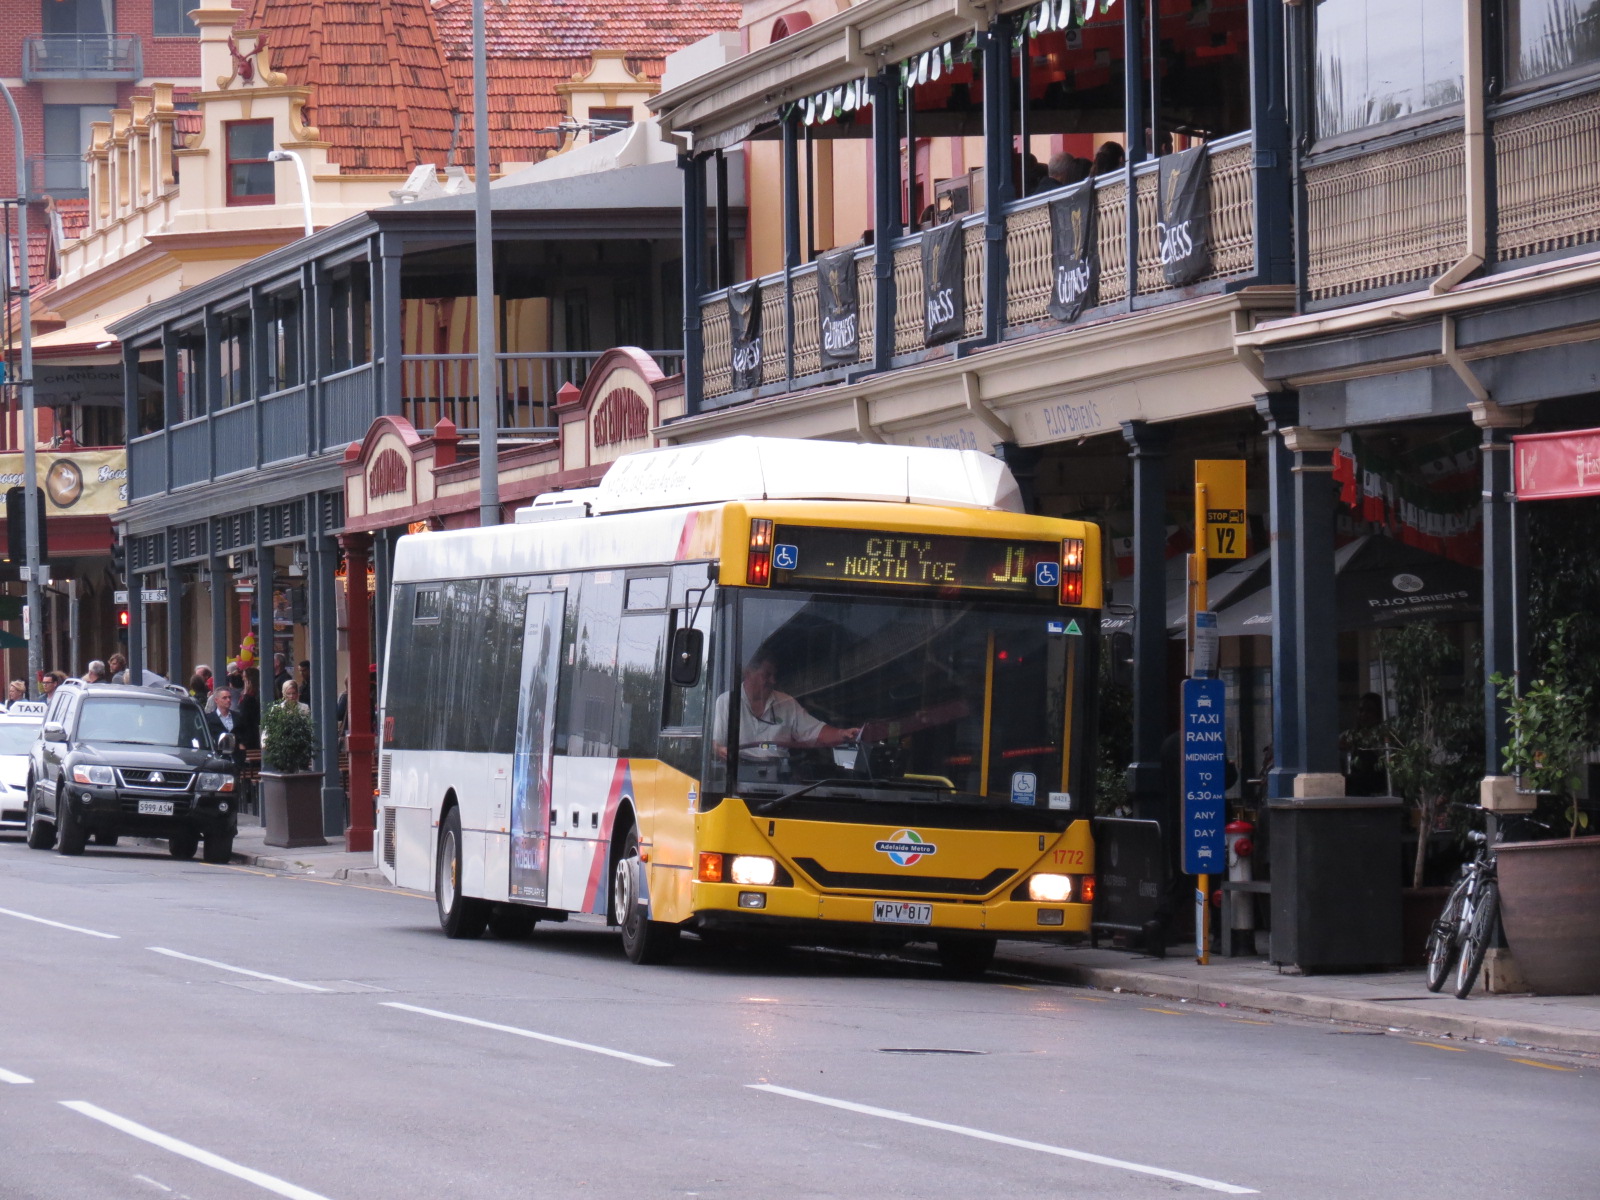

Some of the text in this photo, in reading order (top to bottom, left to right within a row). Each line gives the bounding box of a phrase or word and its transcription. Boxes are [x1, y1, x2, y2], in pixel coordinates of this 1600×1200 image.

[44, 371, 120, 384] CHANDON
[1208, 512, 1228, 521] STOP
[1216, 527, 1236, 554] Y2
[866, 538, 931, 559] CITY
[844, 556, 908, 579] NORTH
[919, 560, 956, 582] TCE
[993, 546, 1027, 584] J1
[1368, 590, 1469, 608] P.J.O'BRIEN'S
[18, 705, 44, 714] TAXI
[1190, 713, 1220, 724] TAXI
[1186, 731, 1223, 742] RANK
[1185, 753, 1224, 761] MIDNIGHT
[1198, 772, 1212, 781] TO
[1194, 811, 1216, 820] ANY
[1194, 829, 1216, 838] DAY
[880, 843, 931, 853] Adelaide Metro
[1053, 849, 1084, 865] 1772
[876, 904, 902, 919] WPV
[908, 906, 931, 921] 817
